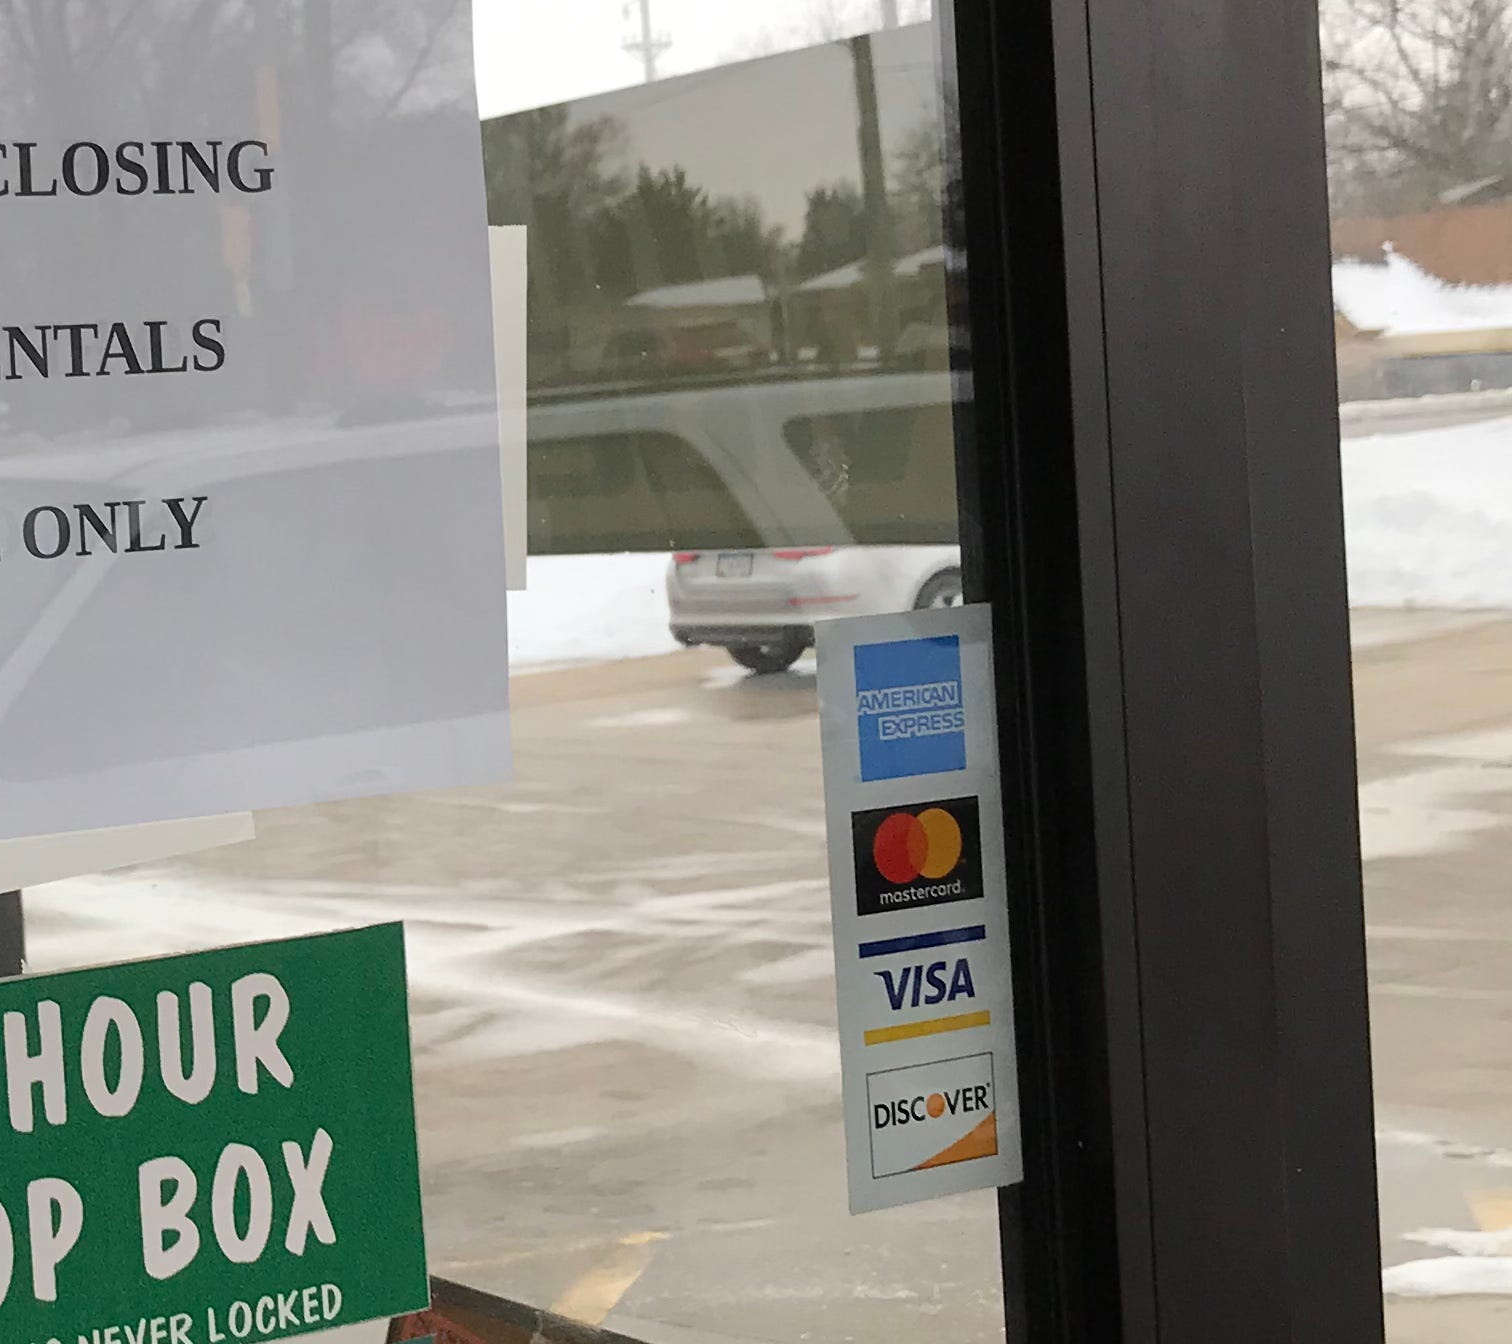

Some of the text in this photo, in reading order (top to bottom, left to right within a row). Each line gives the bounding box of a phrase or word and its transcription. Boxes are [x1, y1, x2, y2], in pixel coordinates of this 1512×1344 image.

[22, 496, 208, 559] ONLY
[857, 683, 958, 712] AMERICAN
[879, 711, 965, 739] EXPRESS
[879, 879, 963, 905] mastercard
[874, 957, 976, 1011] VISA
[3, 971, 294, 1134] HOUR
[873, 1086, 989, 1130] DISCOVER
[138, 1127, 337, 1281] BOX
[207, 1283, 343, 1343] LOCKED
